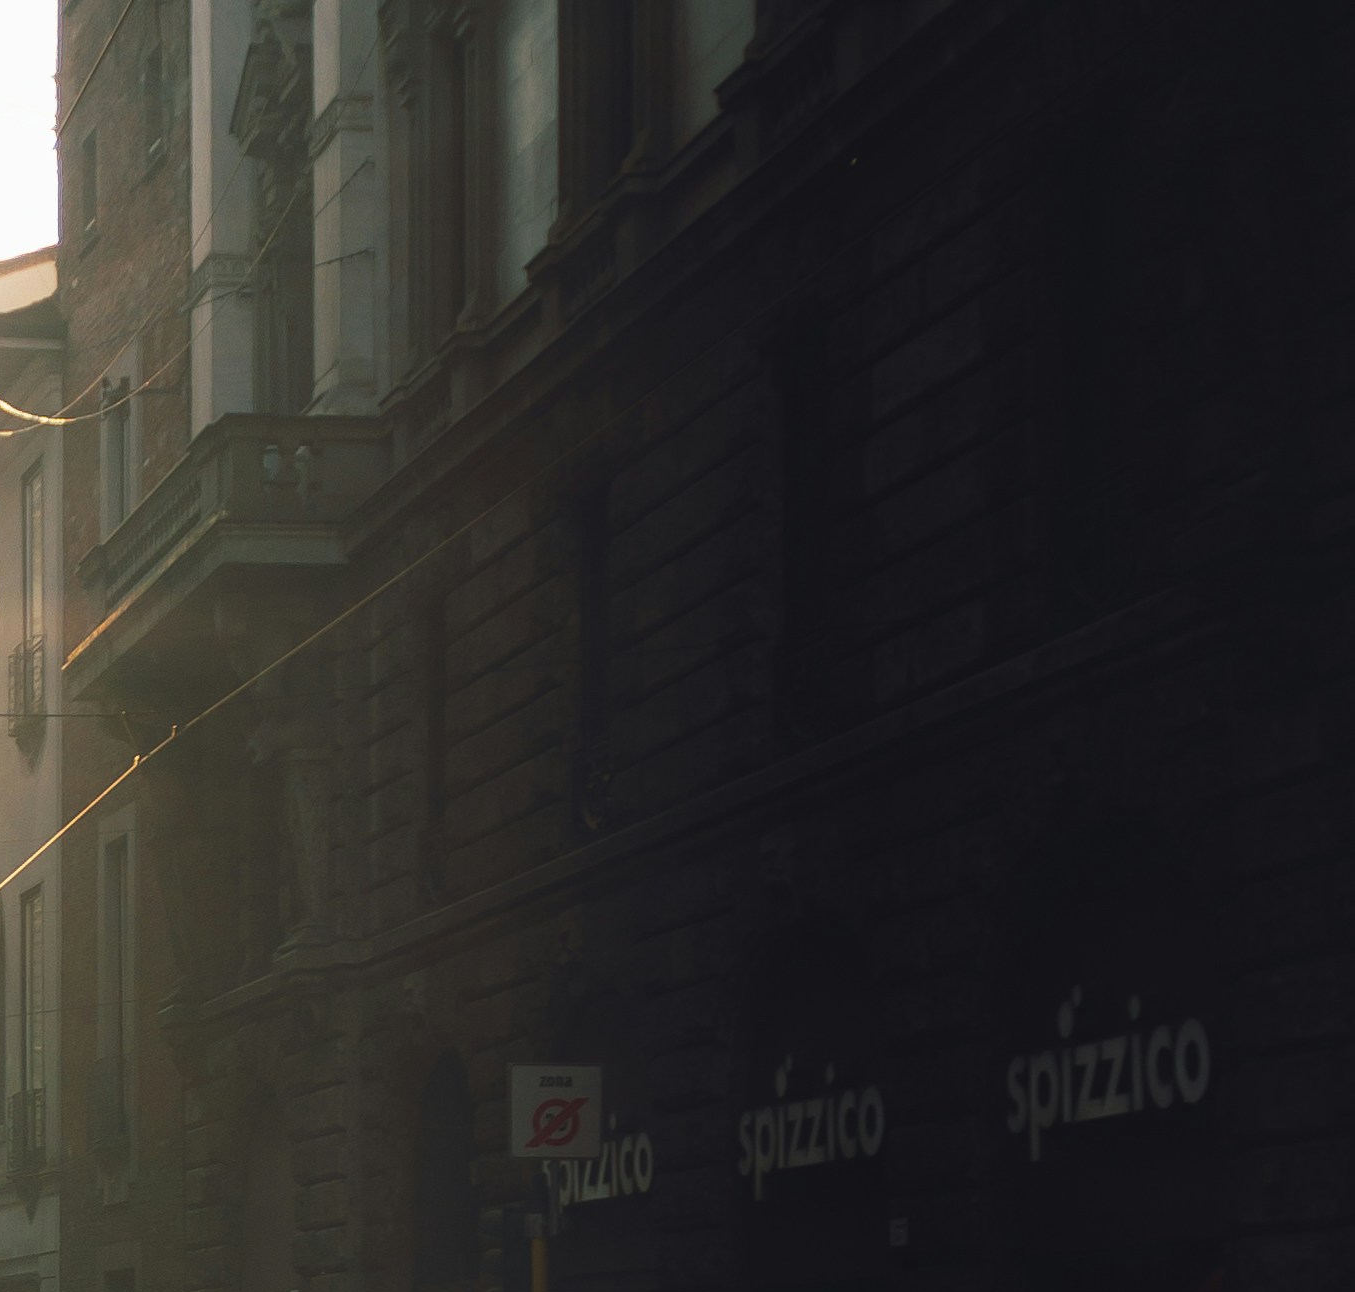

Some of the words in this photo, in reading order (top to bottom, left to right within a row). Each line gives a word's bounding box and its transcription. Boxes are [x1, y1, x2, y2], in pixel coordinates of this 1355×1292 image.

[539, 1075, 574, 1089] zona
[738, 1054, 885, 1201] spizzico
[1006, 984, 1212, 1163] spizzico
